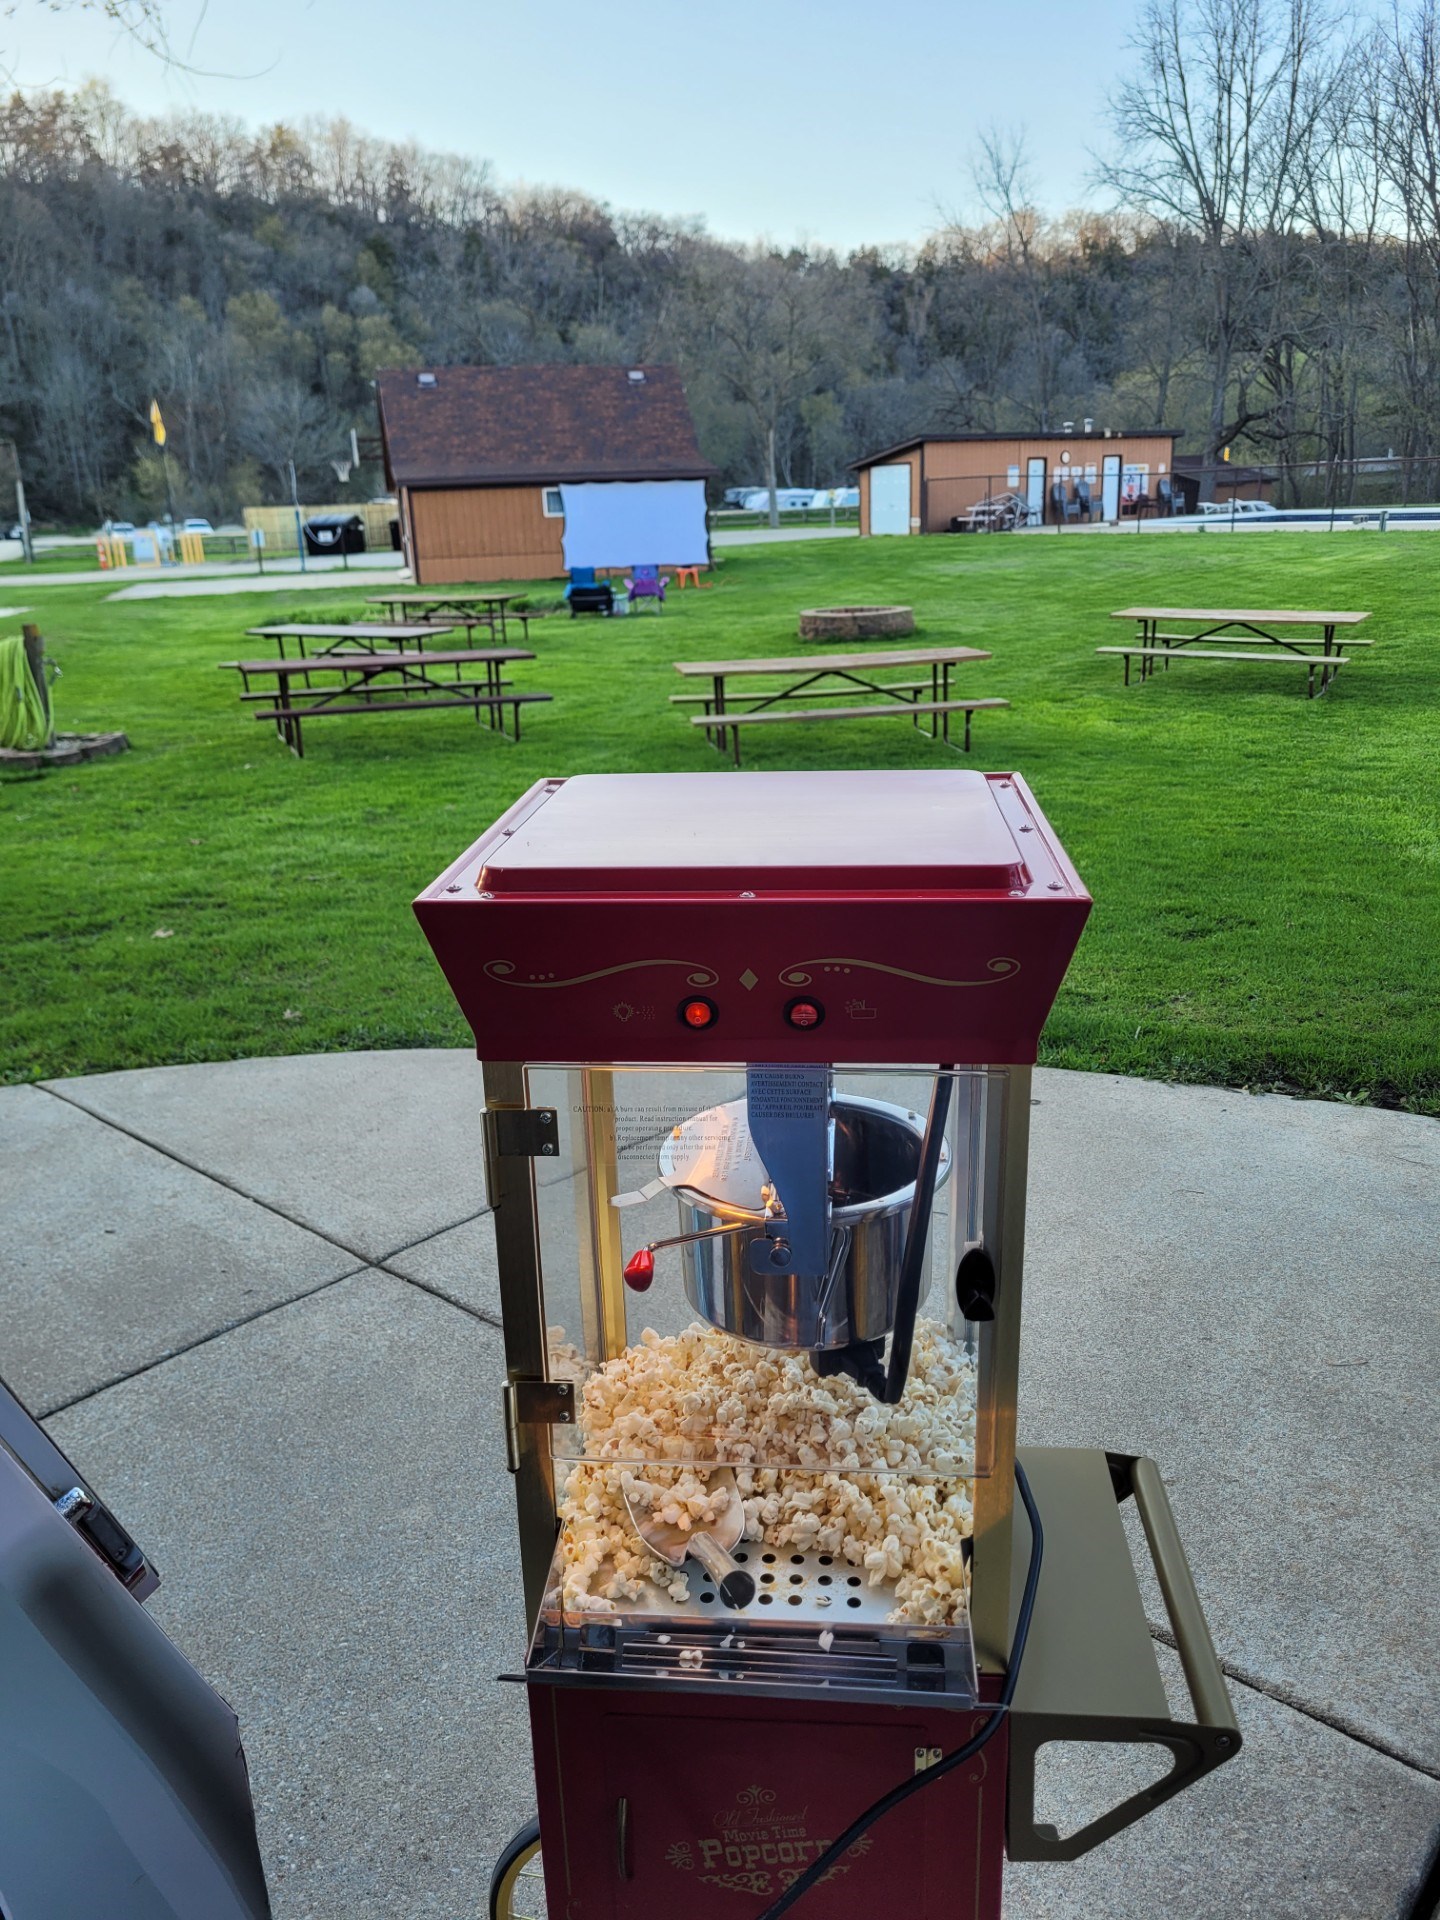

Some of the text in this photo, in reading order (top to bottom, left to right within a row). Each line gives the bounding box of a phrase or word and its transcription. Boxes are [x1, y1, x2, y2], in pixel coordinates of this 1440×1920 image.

[786, 1088, 812, 1096] SURFACE
[572, 1105, 605, 1113] CAUTION:
[645, 1105, 662, 1113] result
[663, 1105, 677, 1113] from
[639, 1114, 654, 1123] Read
[709, 1114, 718, 1122] for
[635, 1125, 662, 1134] operating
[617, 1134, 654, 1143] Replacement
[704, 1134, 733, 1143] servicing
[635, 1143, 665, 1152] performed
[680, 1143, 694, 1151] after
[617, 1153, 655, 1161] disconnected
[655, 1153, 670, 1161] from
[722, 1825, 807, 1843] Movie Time
